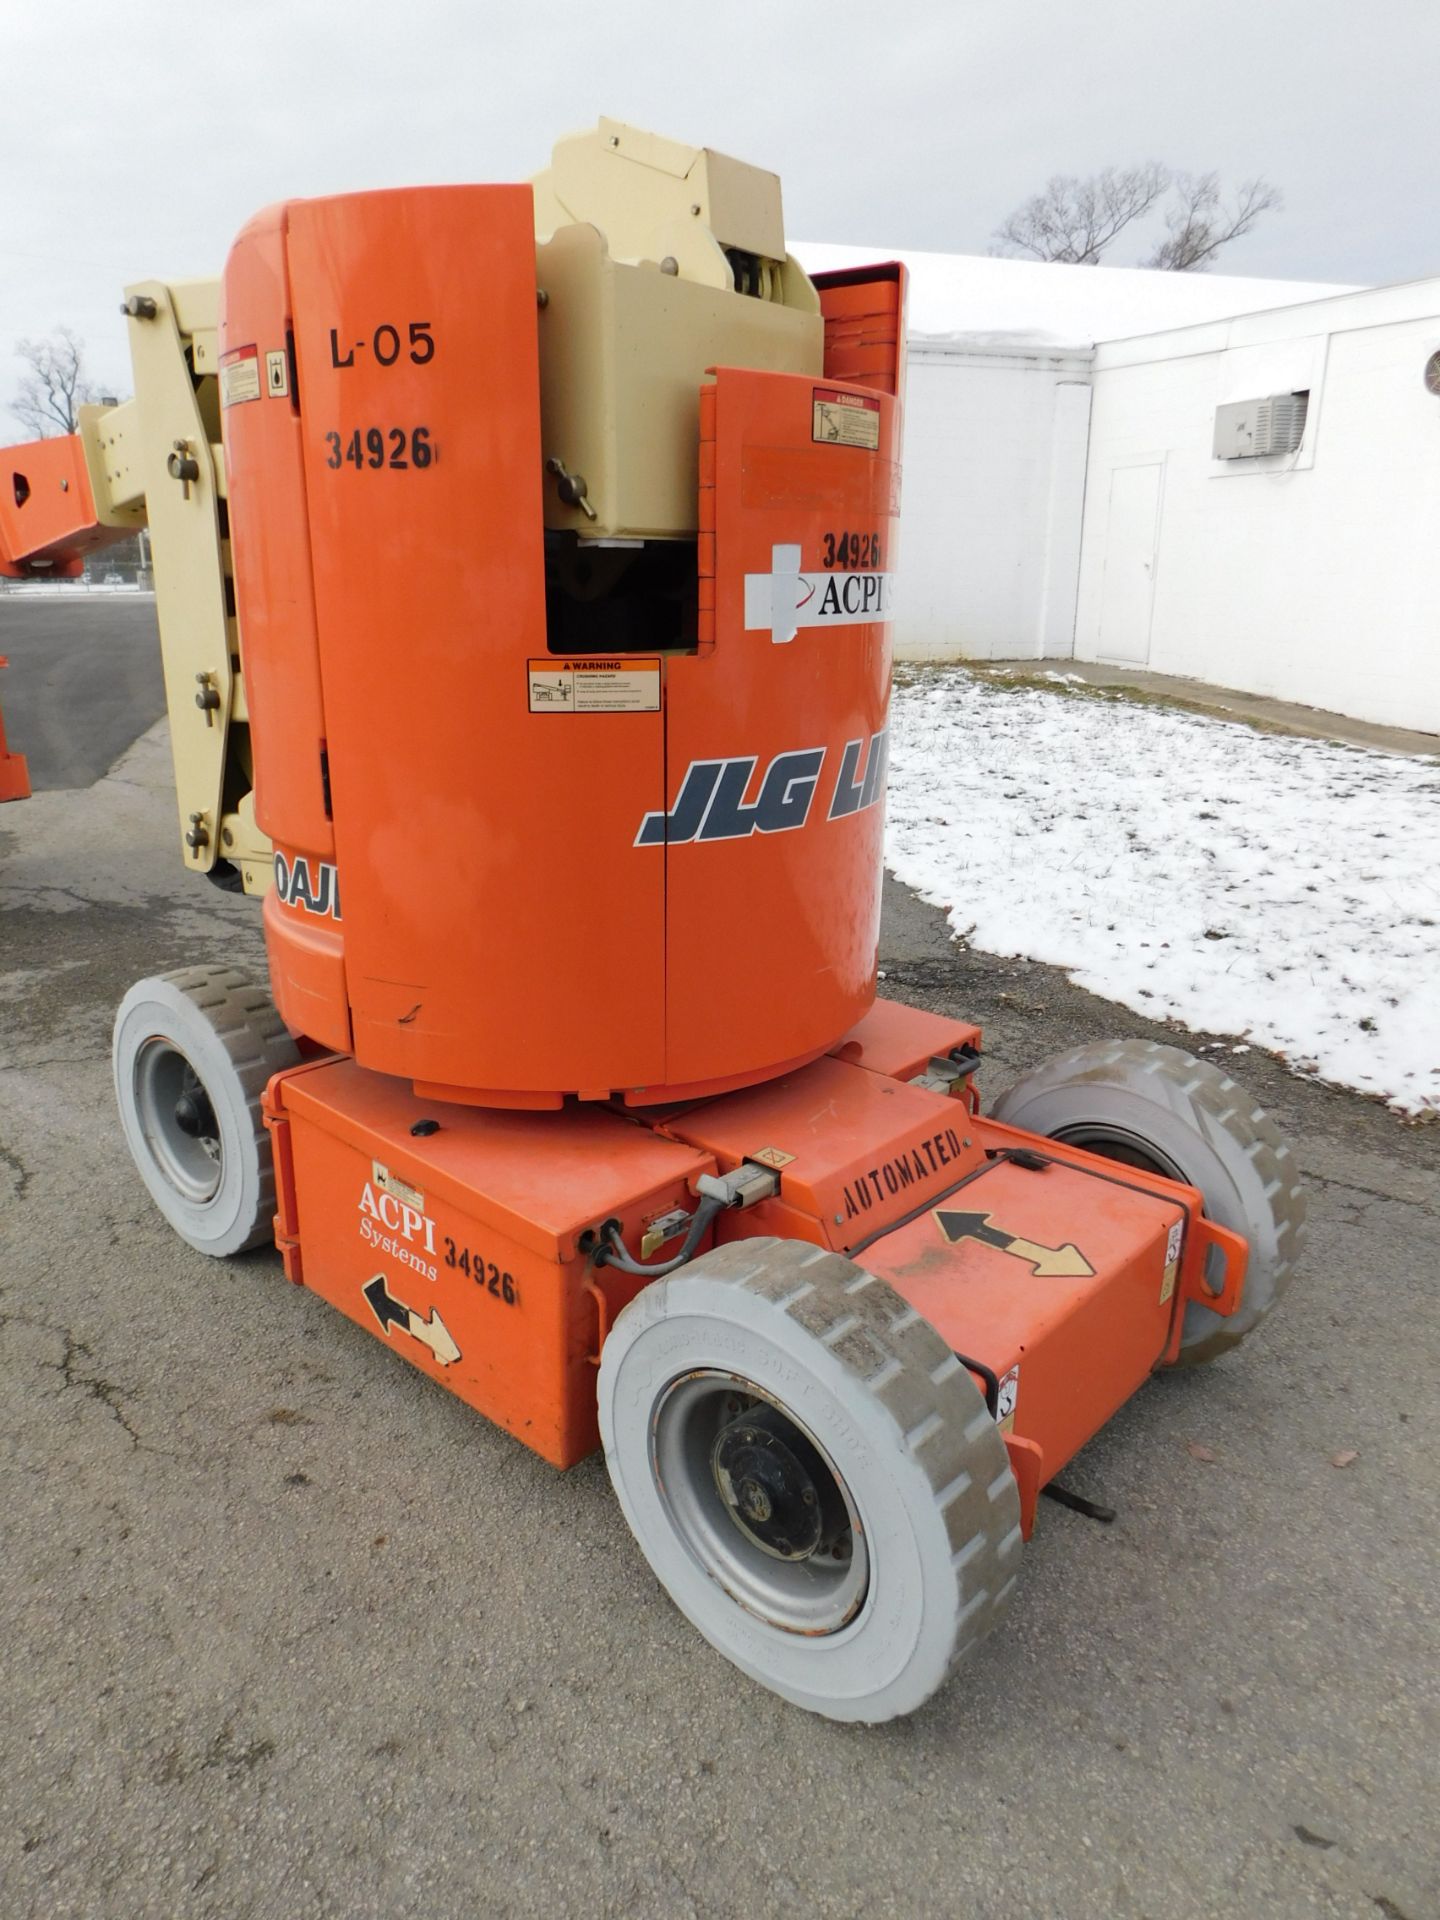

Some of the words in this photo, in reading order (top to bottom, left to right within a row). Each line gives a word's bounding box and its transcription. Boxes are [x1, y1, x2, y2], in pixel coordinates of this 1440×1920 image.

[325, 427, 432, 470] 34926
[823, 531, 879, 570] 34926
[818, 575, 883, 615] ACPI
[572, 662, 622, 670] WARNING
[633, 746, 827, 847] JLG
[843, 1127, 962, 1219] AUTOMATED
[358, 1182, 437, 1256] ACPI
[359, 1217, 438, 1282] Systems
[444, 1237, 515, 1306] 34926
